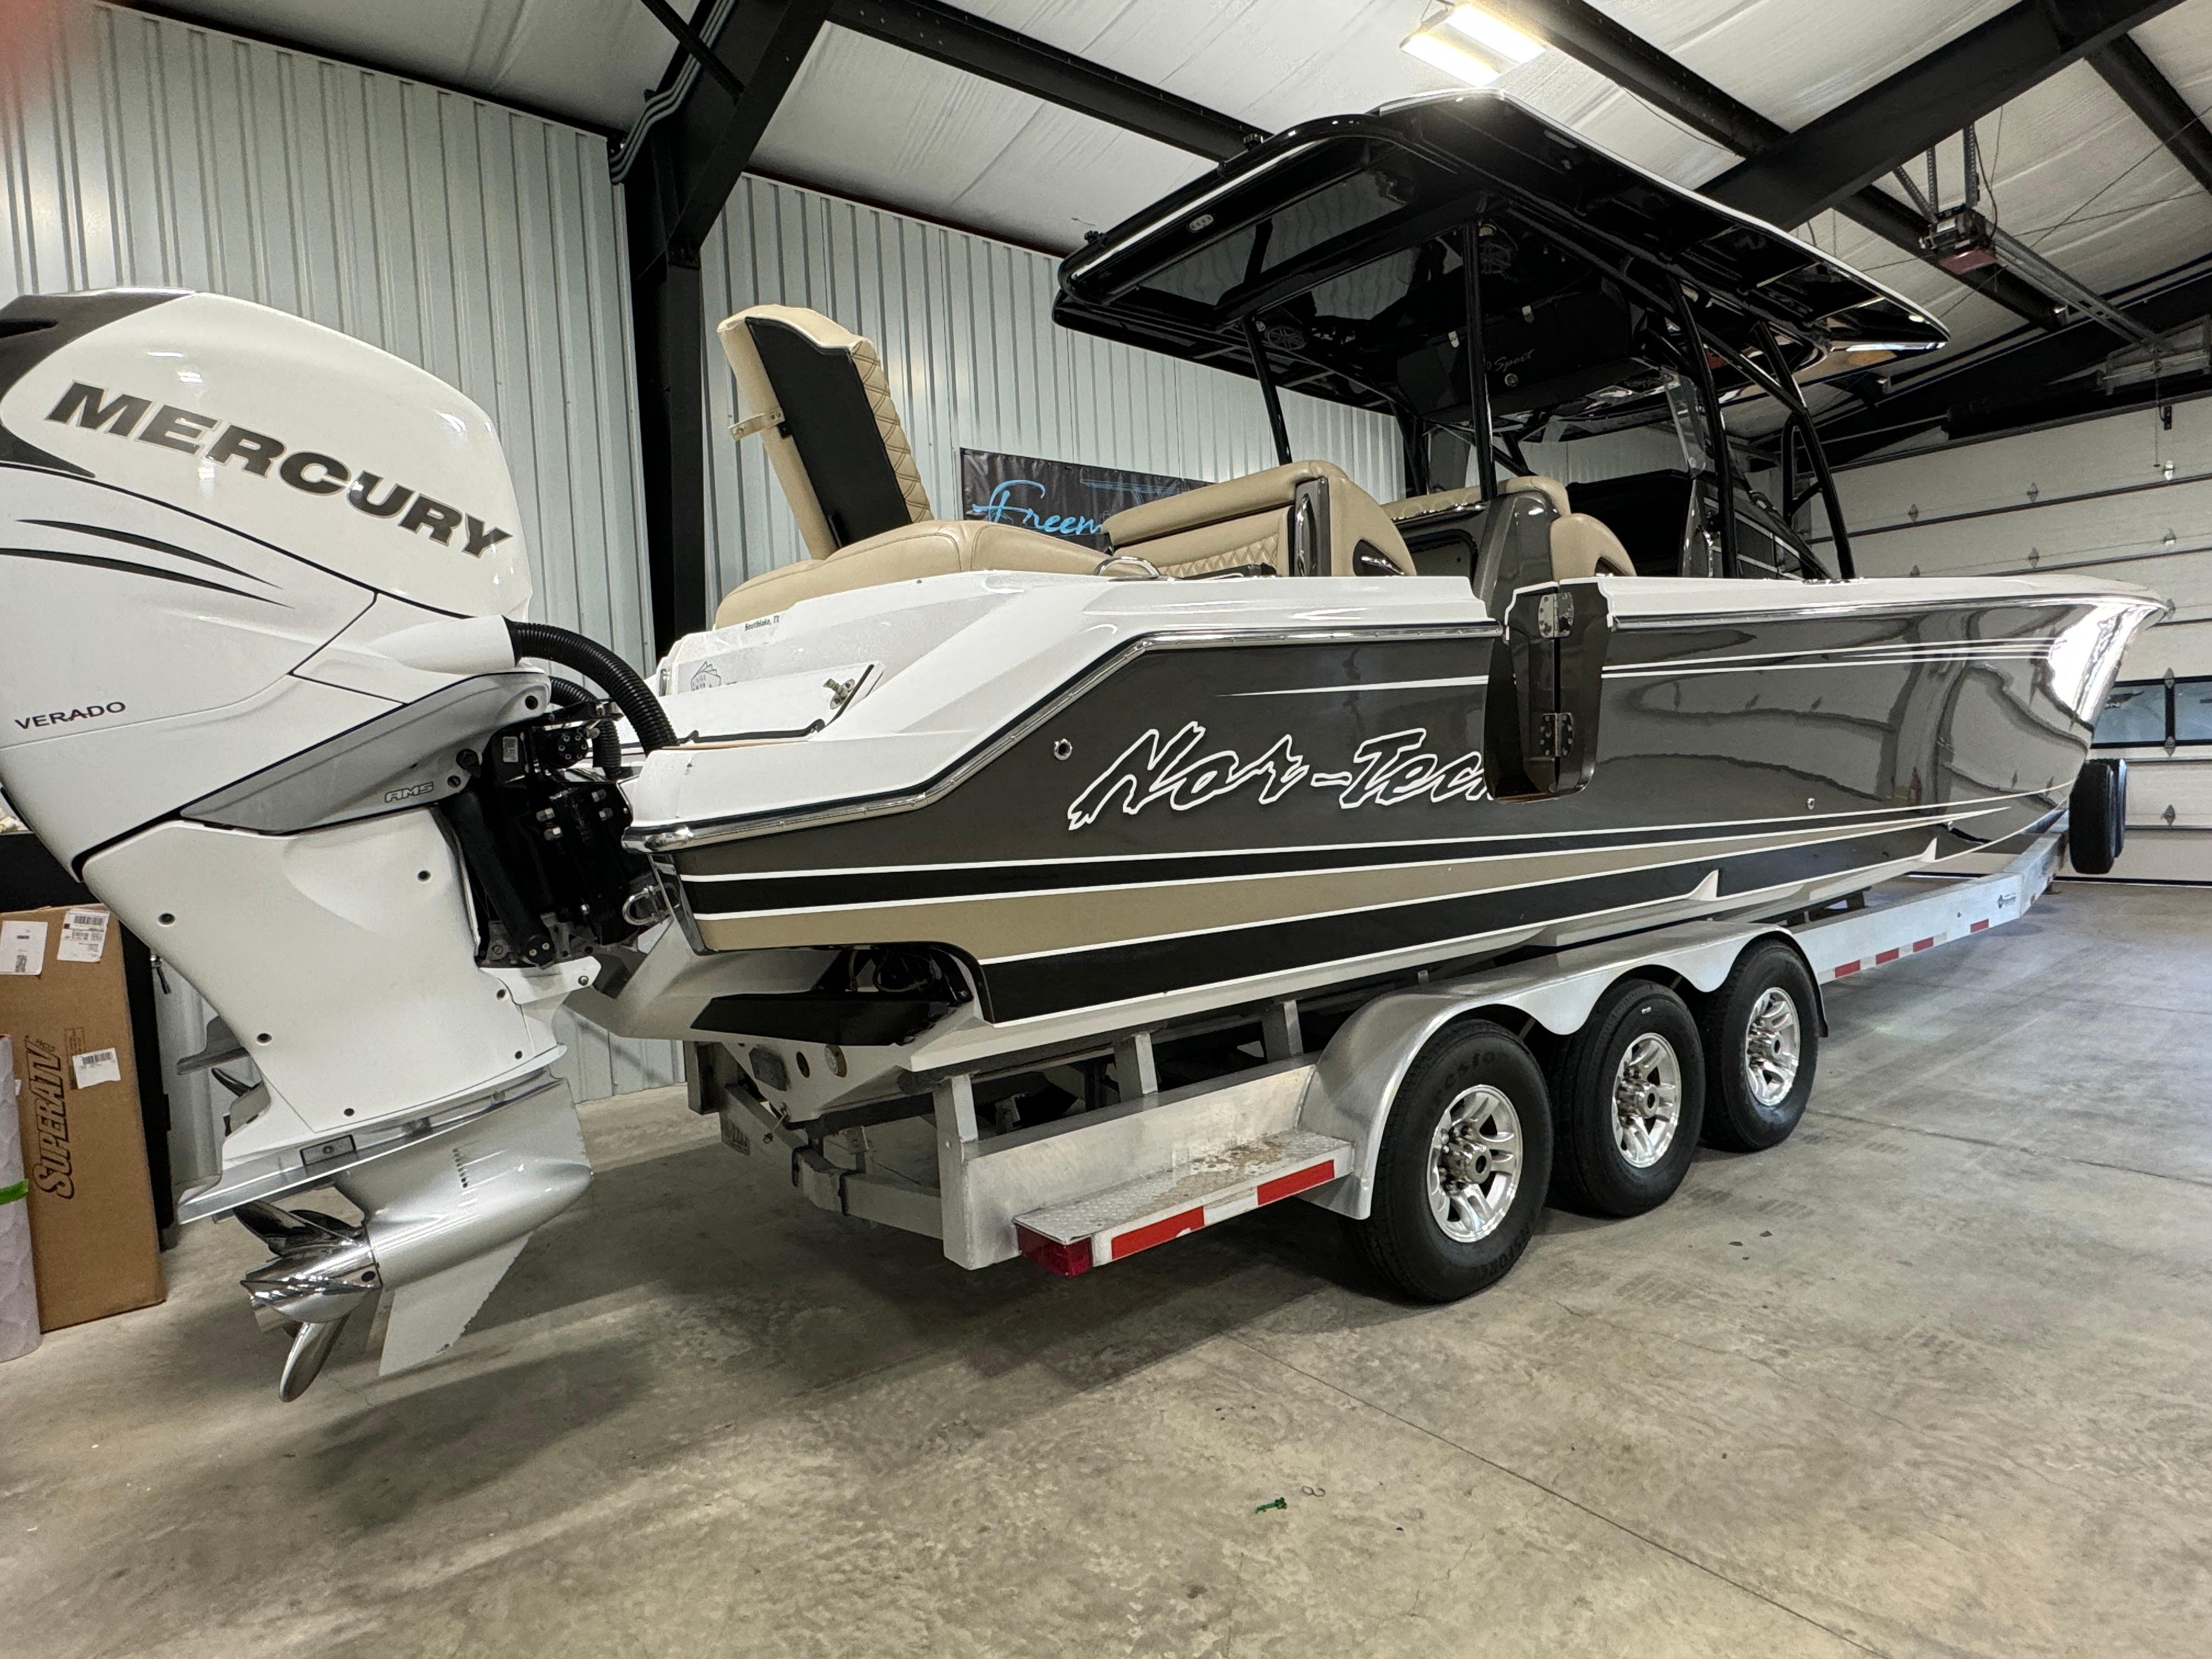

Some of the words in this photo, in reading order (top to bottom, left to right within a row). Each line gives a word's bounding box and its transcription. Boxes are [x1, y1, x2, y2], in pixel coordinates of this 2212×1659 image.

[44, 380, 513, 558] MERCURY
[972, 479, 1103, 535] Freem
[14, 701, 126, 730] VERADO
[385, 781, 435, 803] AMS
[1068, 721, 1494, 831] Nor-Tec
